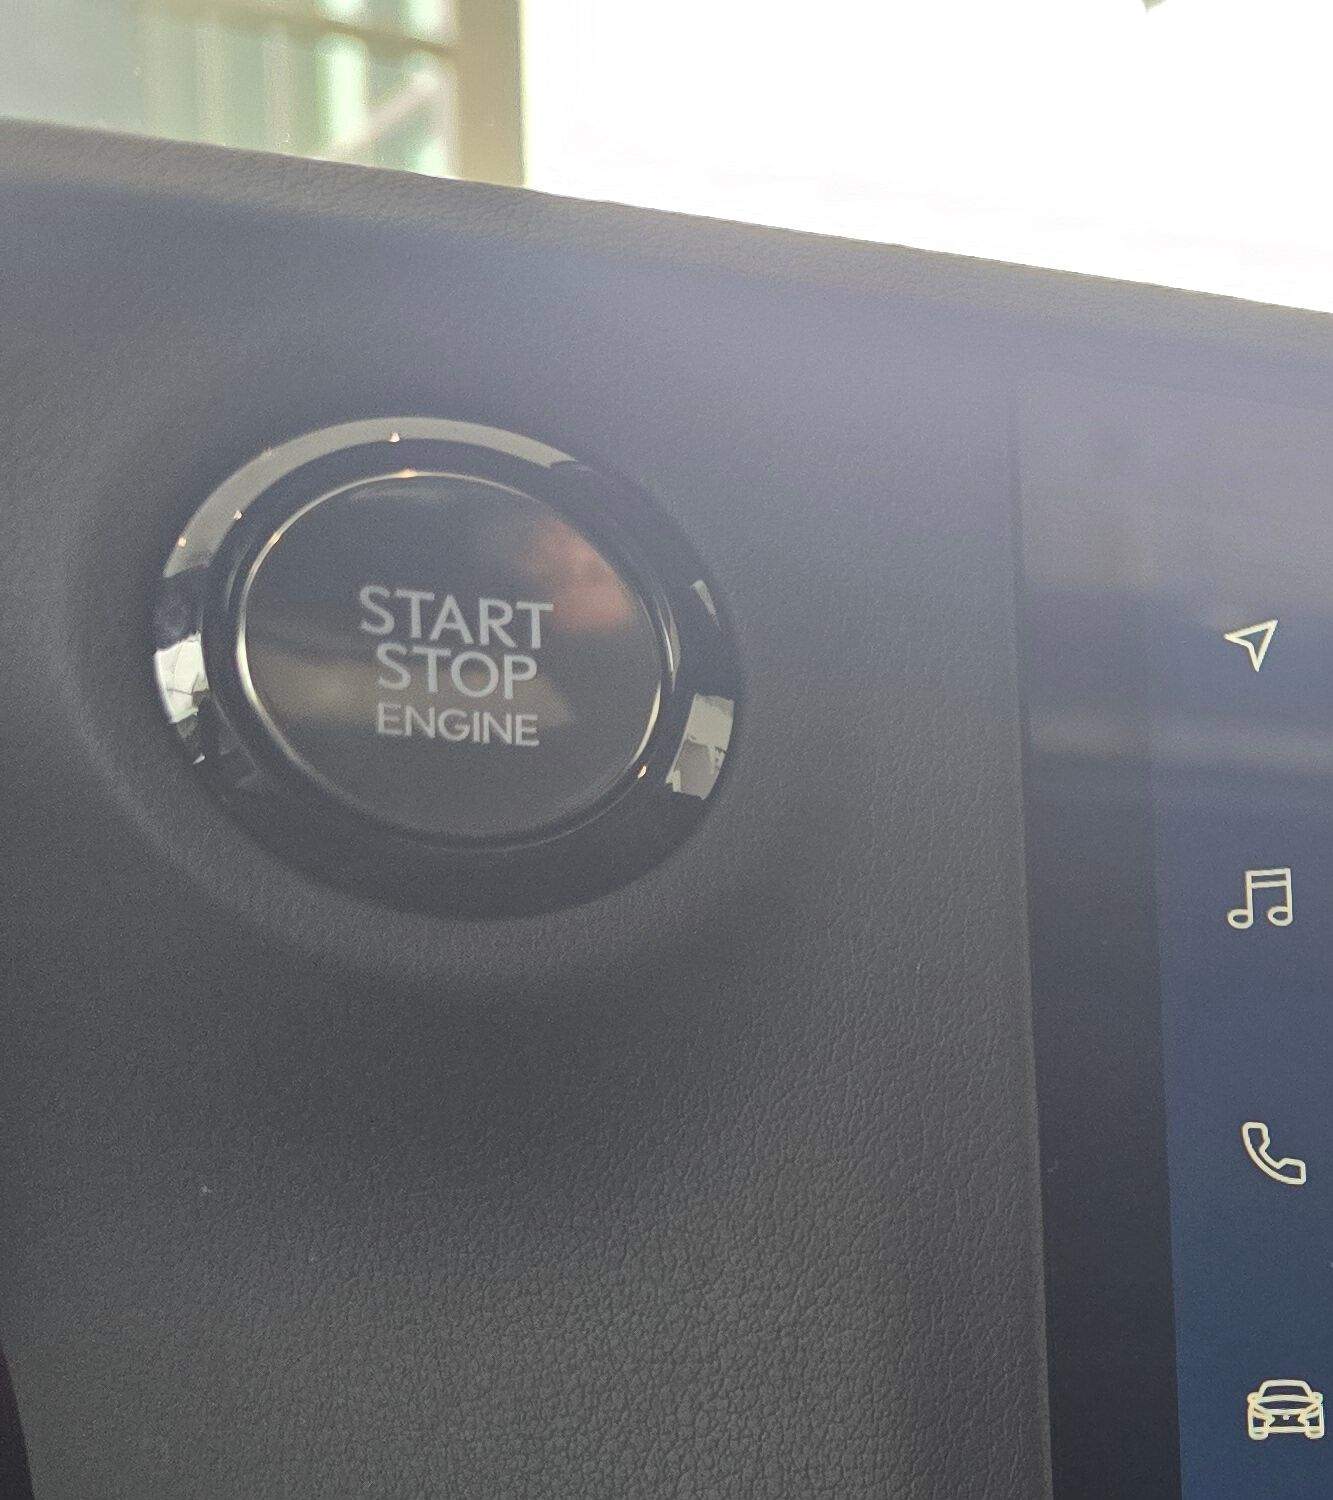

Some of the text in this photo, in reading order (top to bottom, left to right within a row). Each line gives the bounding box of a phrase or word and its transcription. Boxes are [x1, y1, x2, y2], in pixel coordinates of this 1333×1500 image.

[358, 583, 555, 650] START
[376, 642, 538, 702] STOP
[376, 700, 541, 748] ENGINE
